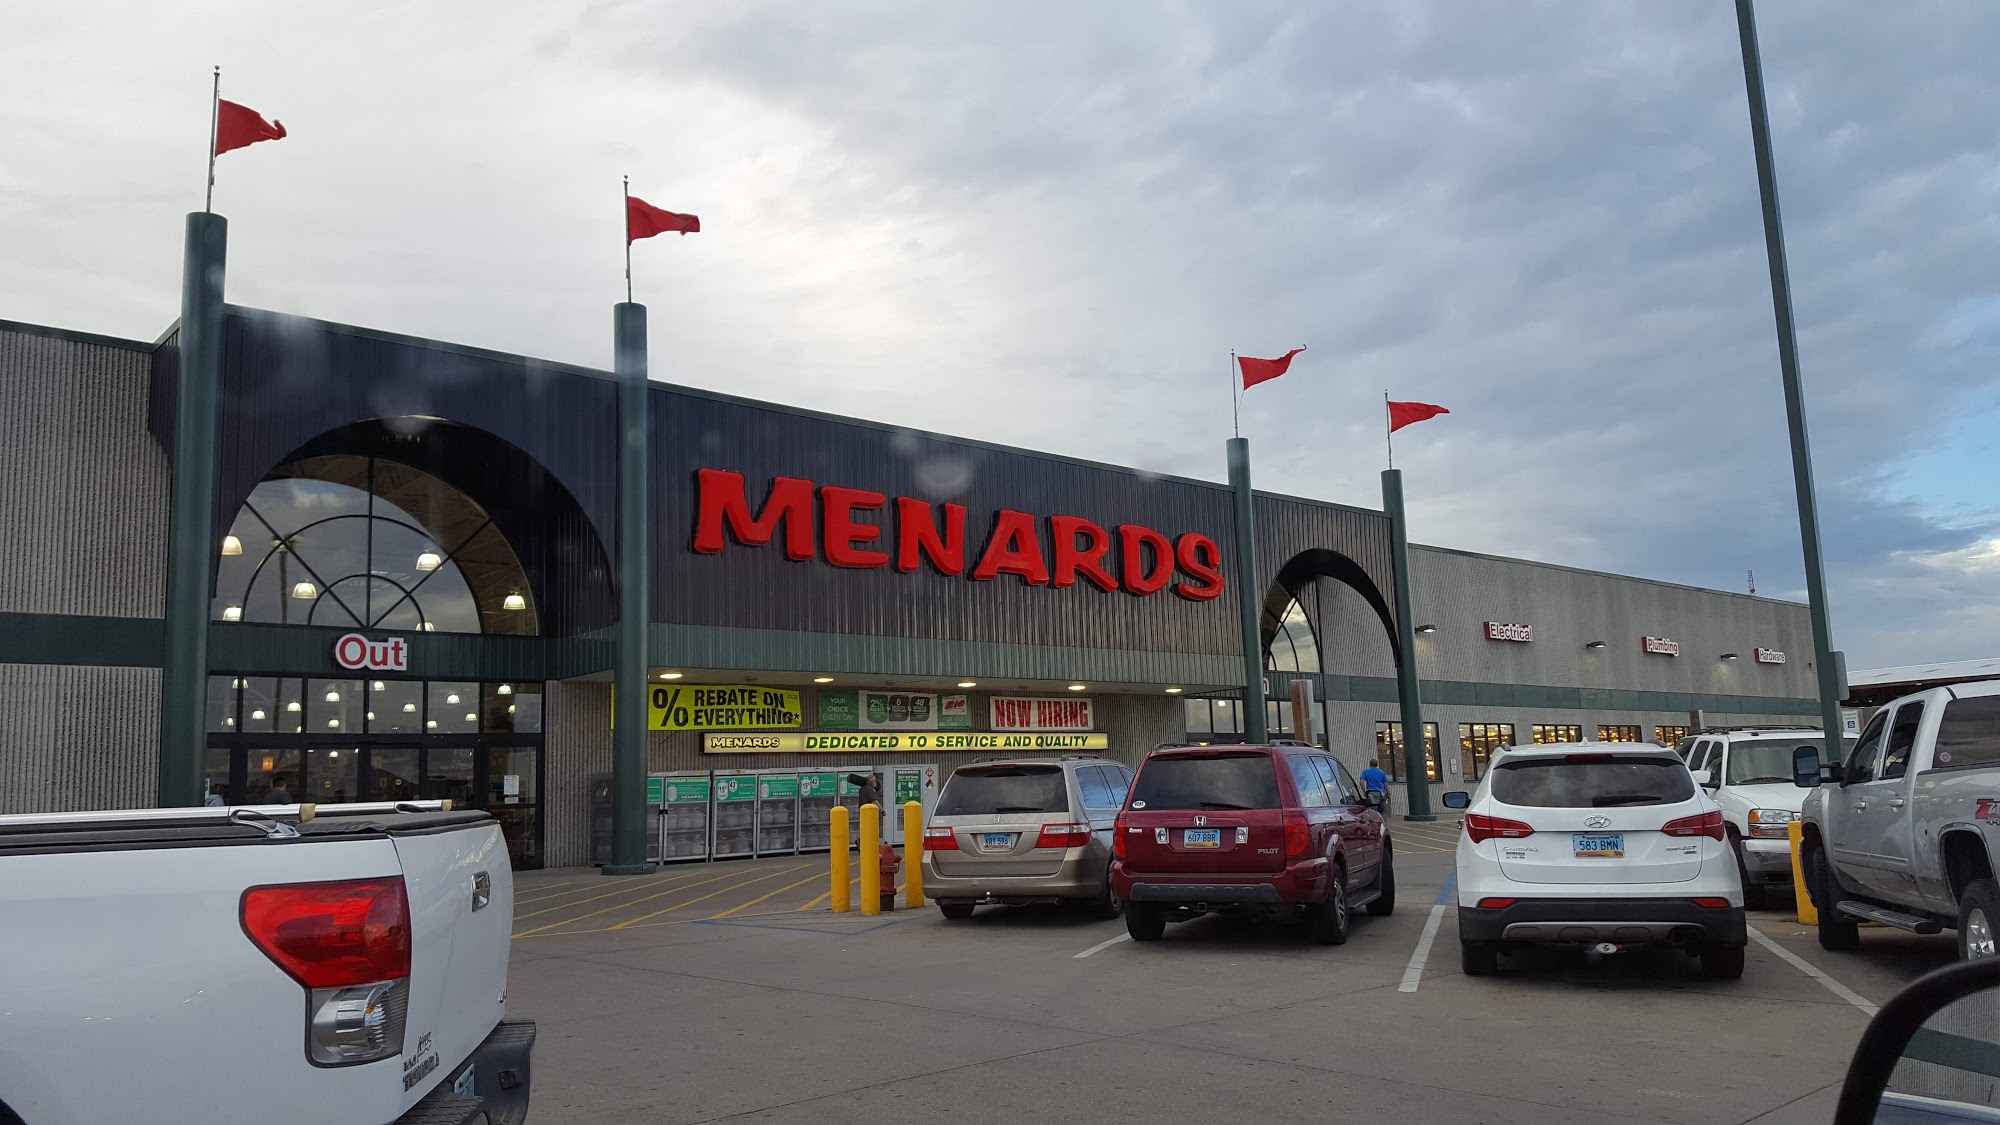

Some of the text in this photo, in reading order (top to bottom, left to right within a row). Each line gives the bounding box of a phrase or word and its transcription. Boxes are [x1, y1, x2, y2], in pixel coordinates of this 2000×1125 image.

[694, 468, 1226, 601] MENARDS
[1489, 623, 1532, 640] Electrical
[337, 635, 405, 668] Out
[1647, 638, 1678, 655] Plumbing
[1759, 649, 1785, 662] Hardware
[694, 689, 785, 708] REBATE ON
[870, 699, 884, 708] 2%
[995, 700, 1088, 727] NOW HIRING
[711, 736, 1088, 749] MENARDS DEDICATED TO SERVICE AND QUALITY
[997, 837, 1009, 845] 596
[1187, 833, 1216, 842] 607 BBR
[1579, 840, 1619, 850] 583 BMN
